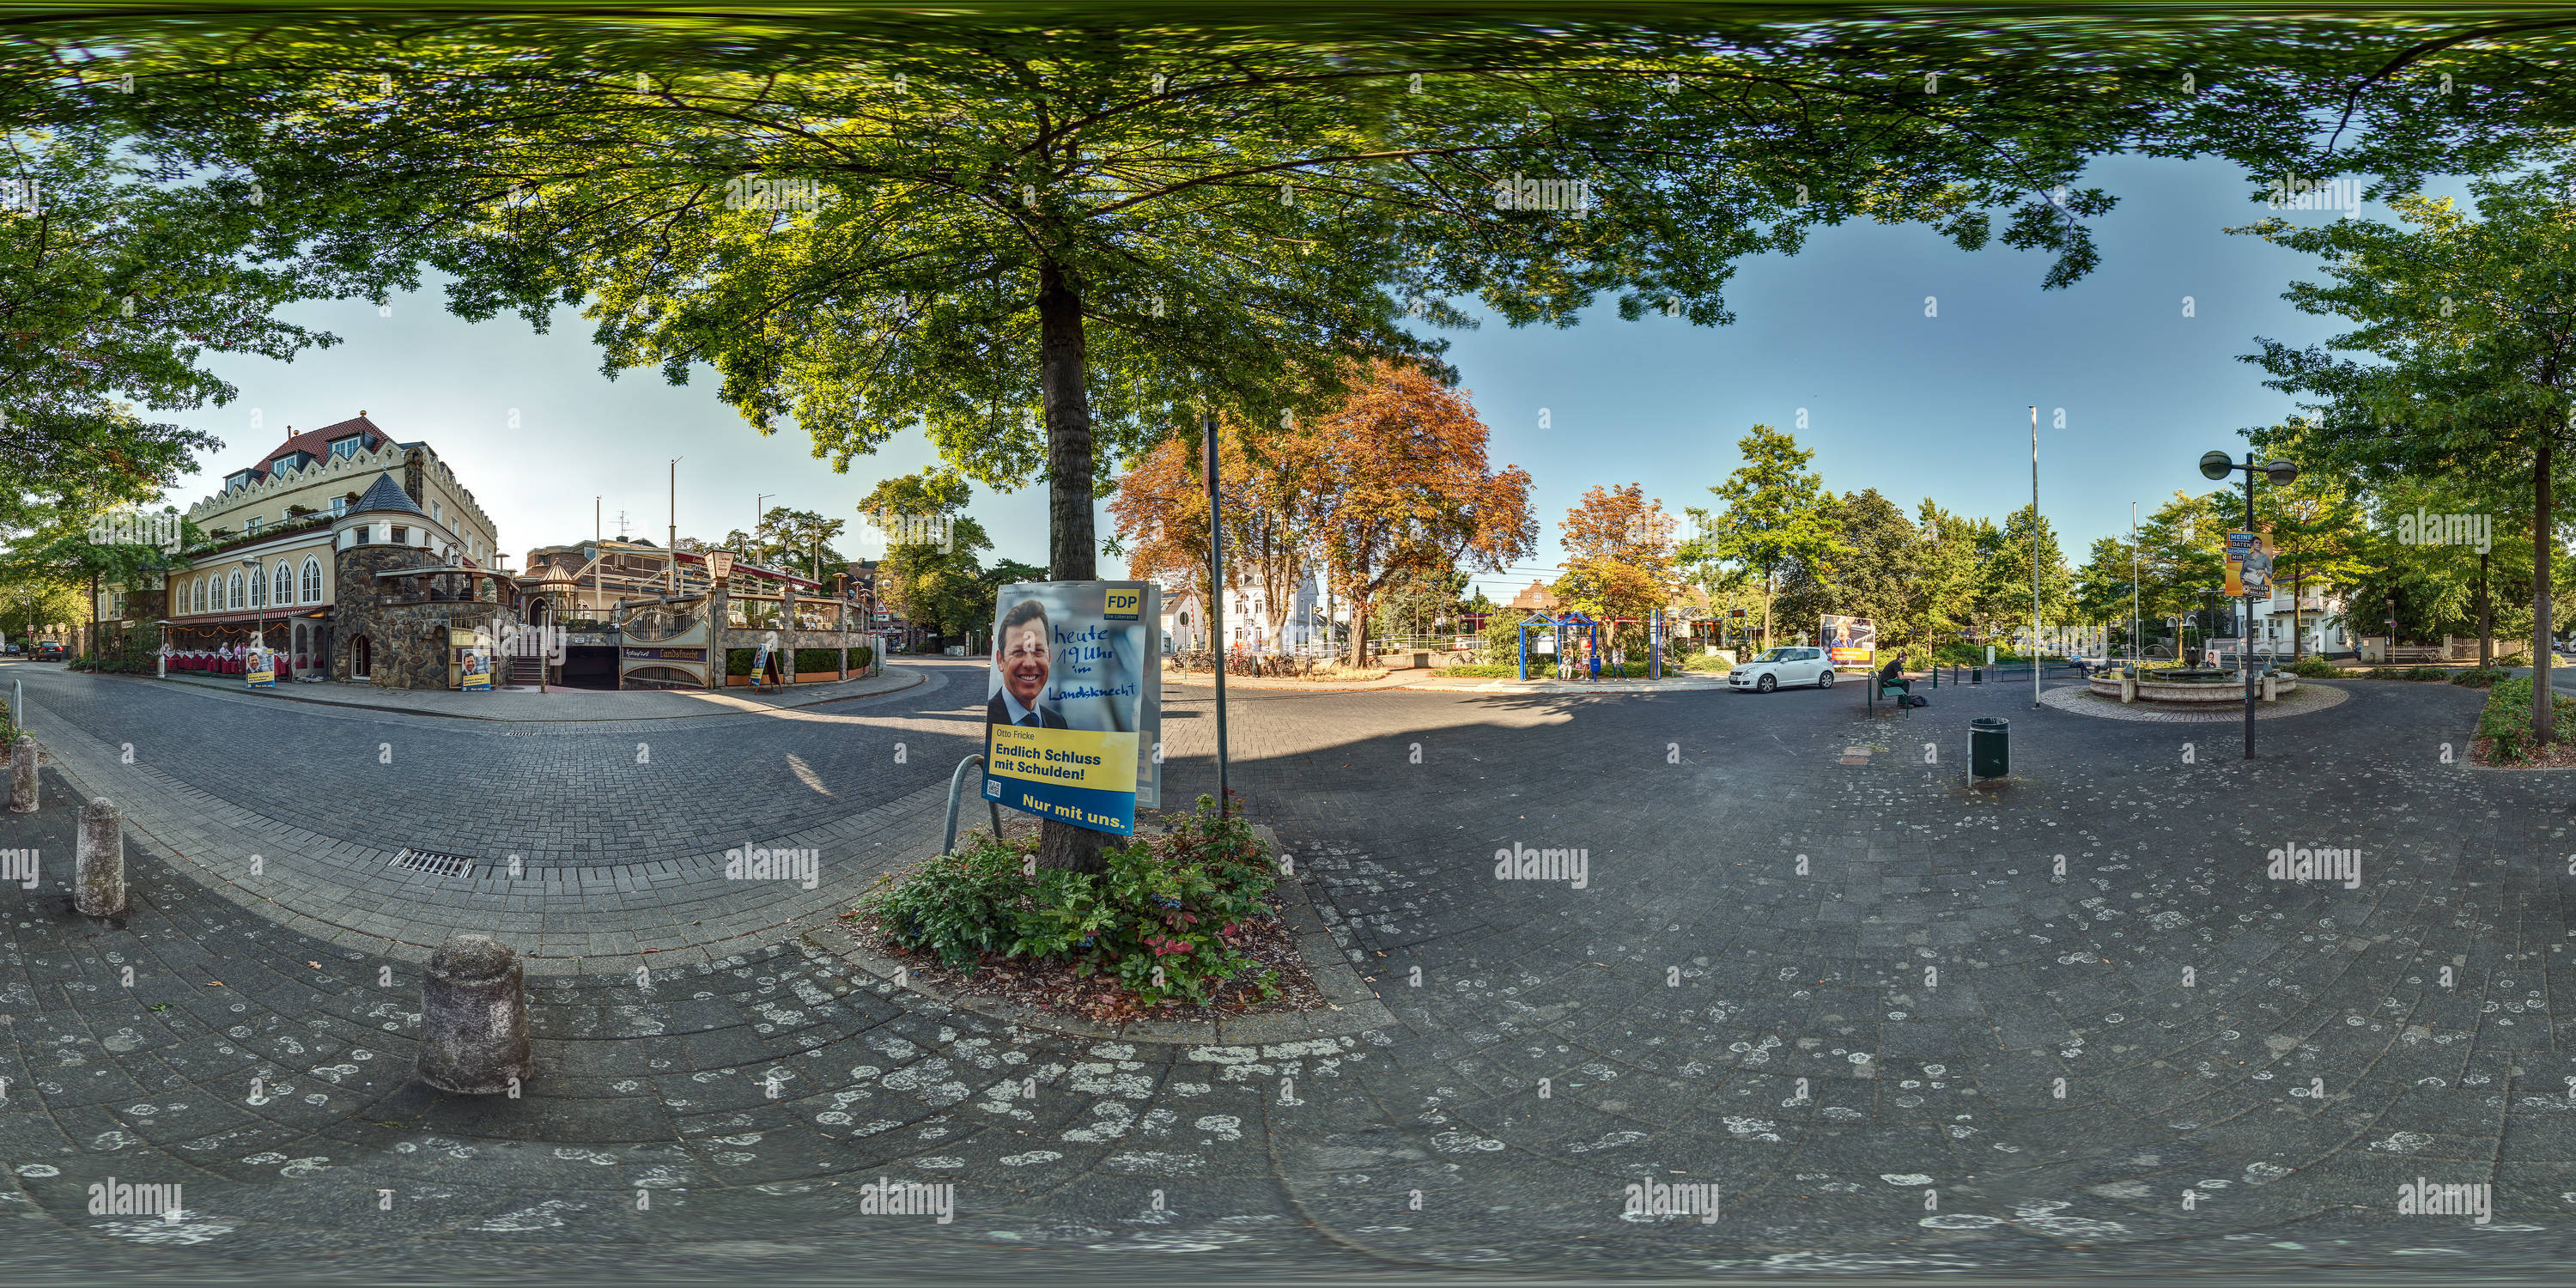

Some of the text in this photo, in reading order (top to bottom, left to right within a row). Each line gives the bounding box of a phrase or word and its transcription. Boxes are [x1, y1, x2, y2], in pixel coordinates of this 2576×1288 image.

[1108, 595, 1138, 608] FDP
[1054, 624, 1109, 644] heute
[1056, 646, 1113, 664] 19 Uhr
[1072, 665, 1091, 673] im
[1048, 682, 1137, 701] Landsknecht
[996, 729, 1035, 740] Otto Fricke
[995, 743, 1101, 765] Endlich Schluss
[994, 759, 1084, 781] mit Schulden!
[1023, 793, 1126, 829] Nur mit uns.
